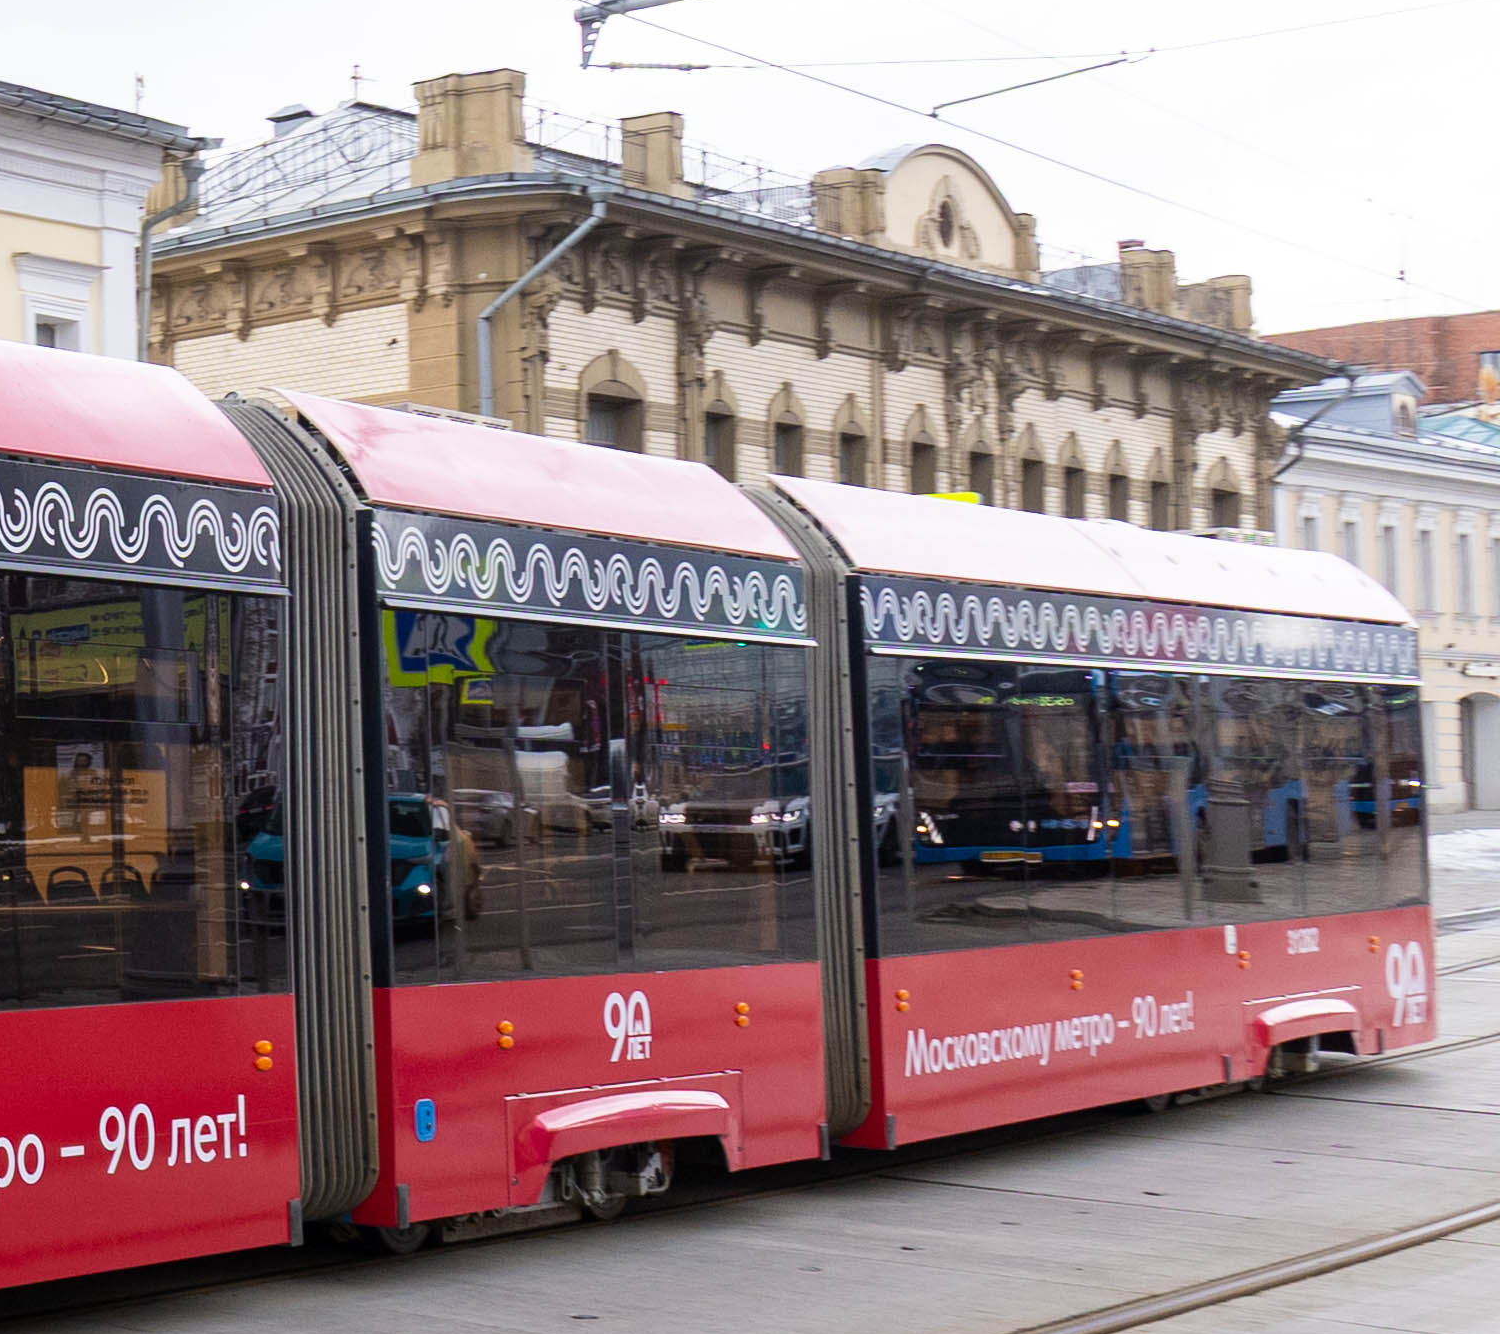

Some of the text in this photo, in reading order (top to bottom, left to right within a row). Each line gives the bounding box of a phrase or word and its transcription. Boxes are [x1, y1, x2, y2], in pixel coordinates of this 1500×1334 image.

[603, 990, 651, 1063] 90
[626, 1036, 653, 1061] ЛЕТ
[904, 1022, 1052, 1077] Московскому
[1054, 1013, 1115, 1057] метро
[1131, 995, 1158, 1039] 90
[99, 1102, 156, 1176] 90
[166, 1093, 248, 1169] лет!
